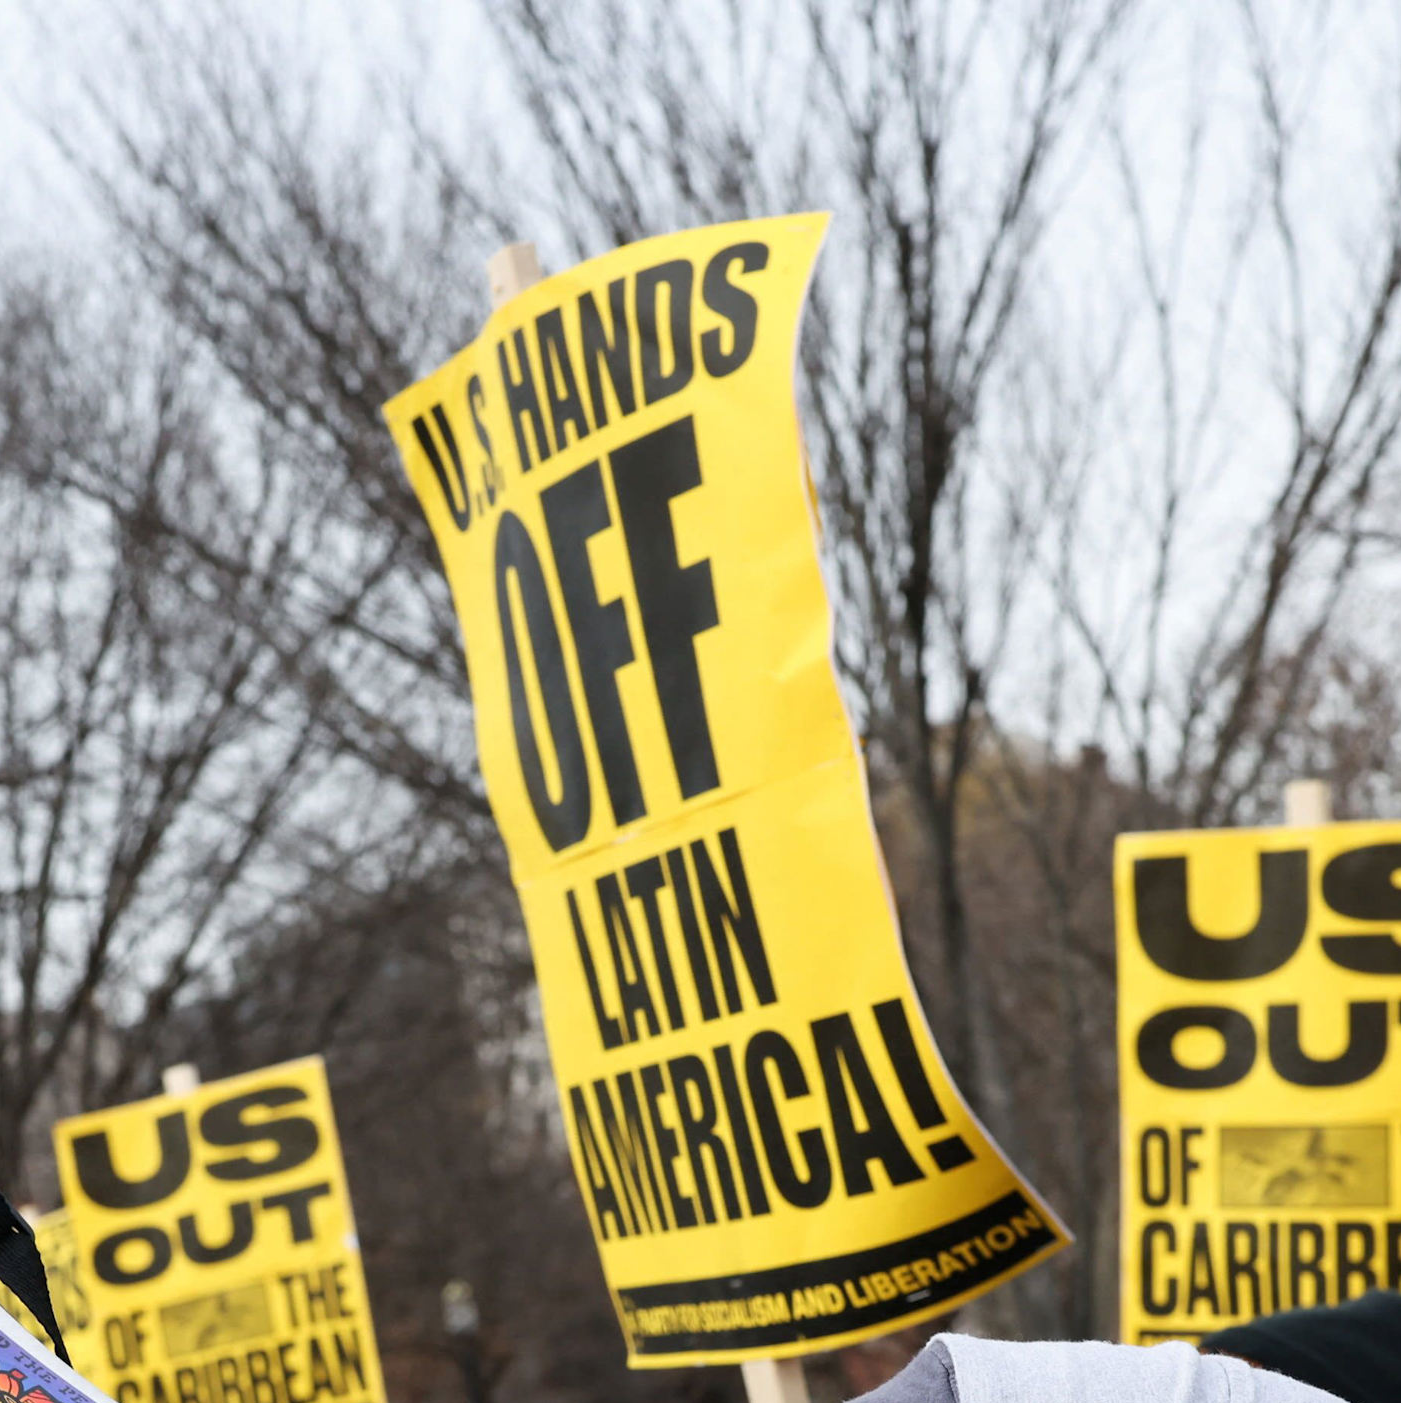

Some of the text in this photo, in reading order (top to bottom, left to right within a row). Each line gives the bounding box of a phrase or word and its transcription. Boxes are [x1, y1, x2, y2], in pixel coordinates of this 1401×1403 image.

[497, 241, 770, 475] HANDS
[494, 414, 720, 853] OFF
[565, 826, 779, 1051] LATIN
[70, 1085, 321, 1211] US
[568, 996, 977, 1241] AMERICA!
[1138, 1125, 1205, 1208] OF
[92, 1180, 333, 1287] OUT
[699, 1292, 791, 1332] SOCIALISM
[792, 1284, 846, 1320] AND
[846, 1208, 1045, 1309] LIBERATION
[13, 1350, 55, 1385] THE
[105, 1263, 354, 1371] OF THE
